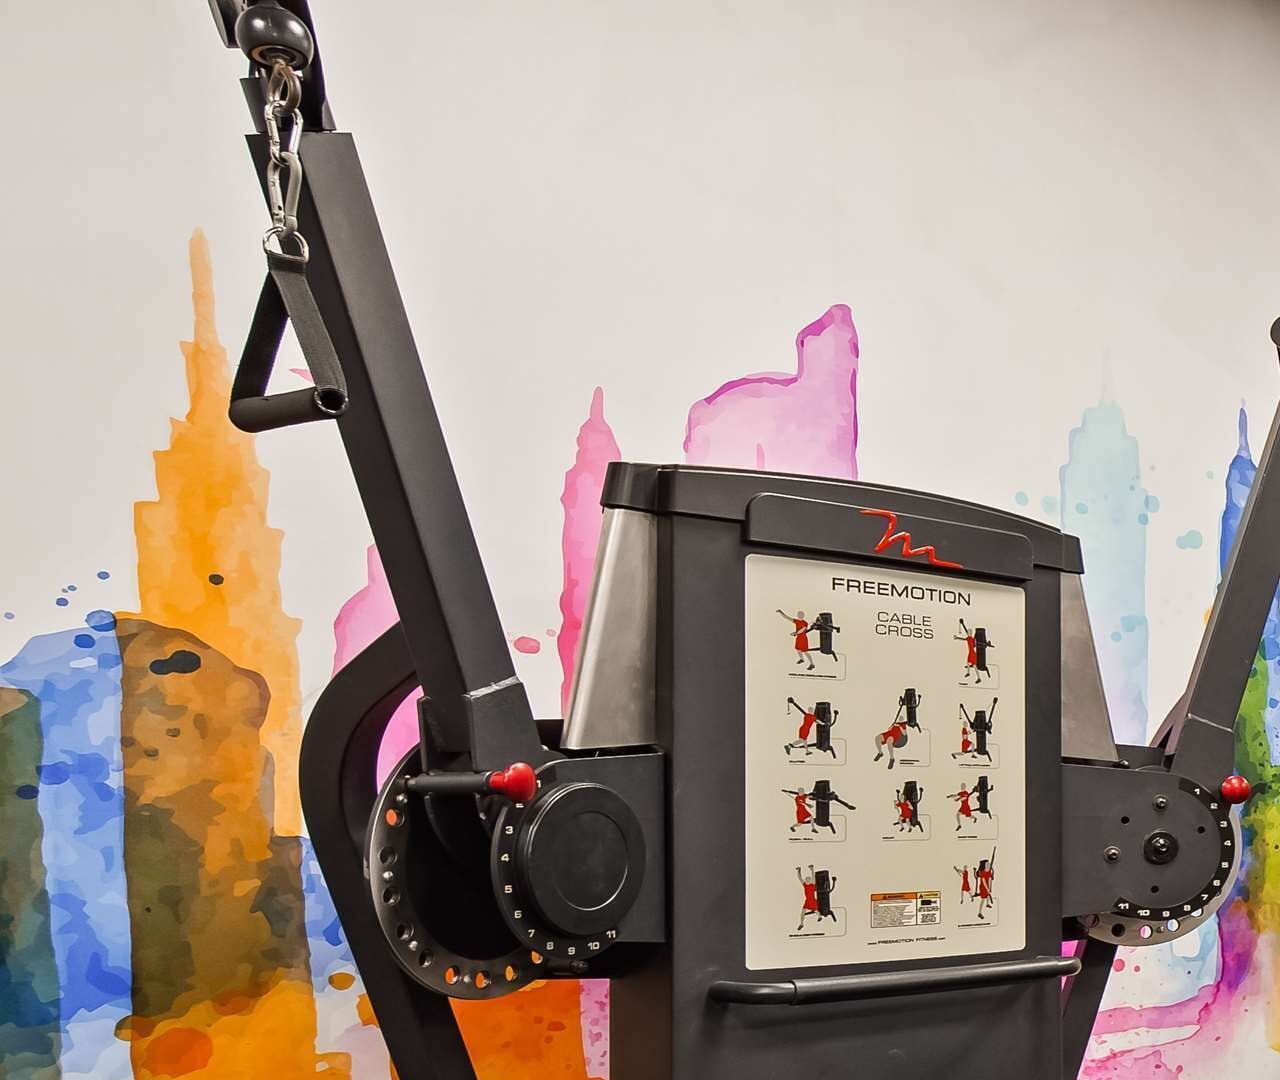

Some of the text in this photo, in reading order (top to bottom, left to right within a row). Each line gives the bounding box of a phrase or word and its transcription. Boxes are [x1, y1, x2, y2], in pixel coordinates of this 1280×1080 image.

[832, 577, 971, 606] FREEMOTION
[877, 611, 932, 626] CABLE
[875, 624, 934, 640] CROSS
[1210, 802, 1218, 810] 2
[1219, 820, 1228, 828] 3
[505, 825, 514, 835] 3
[500, 853, 510, 862] 4
[1221, 861, 1229, 869] 5
[1212, 879, 1221, 887] 6
[504, 885, 513, 894] 5
[1118, 902, 1130, 910] 11
[514, 910, 522, 919] 6
[1137, 909, 1151, 917] 10
[528, 929, 536, 938] 7
[606, 930, 616, 939] 11
[546, 941, 554, 951] 8
[587, 941, 600, 950] 10
[567, 946, 576, 956] 9
